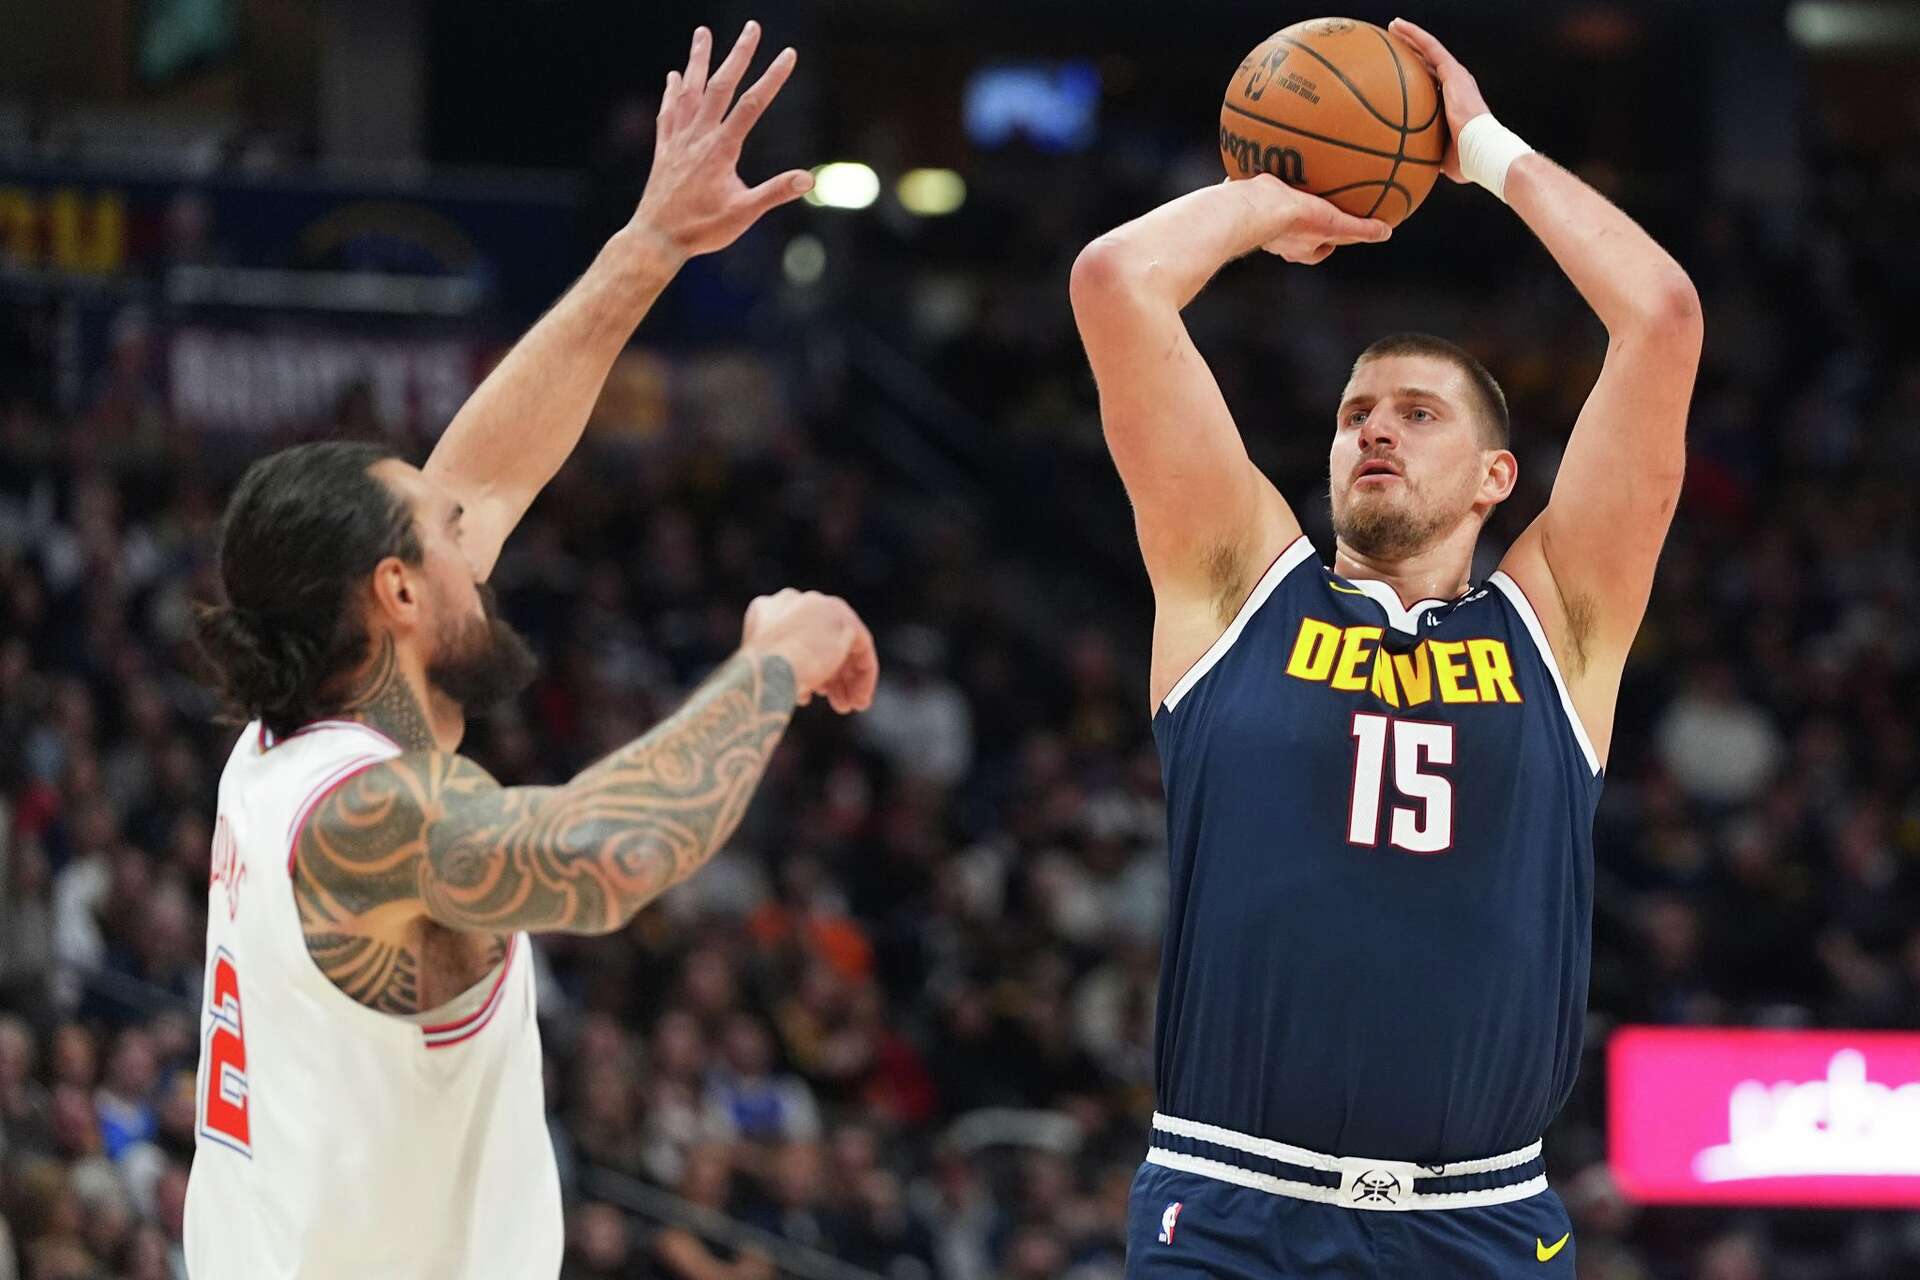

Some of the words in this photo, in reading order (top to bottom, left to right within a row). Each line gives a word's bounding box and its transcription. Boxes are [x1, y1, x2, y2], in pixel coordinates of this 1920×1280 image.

[1219, 127, 1307, 184] Wilso
[1285, 616, 1524, 709] DENVER
[1346, 711, 1456, 855] 15
[200, 945, 253, 1161] 2
